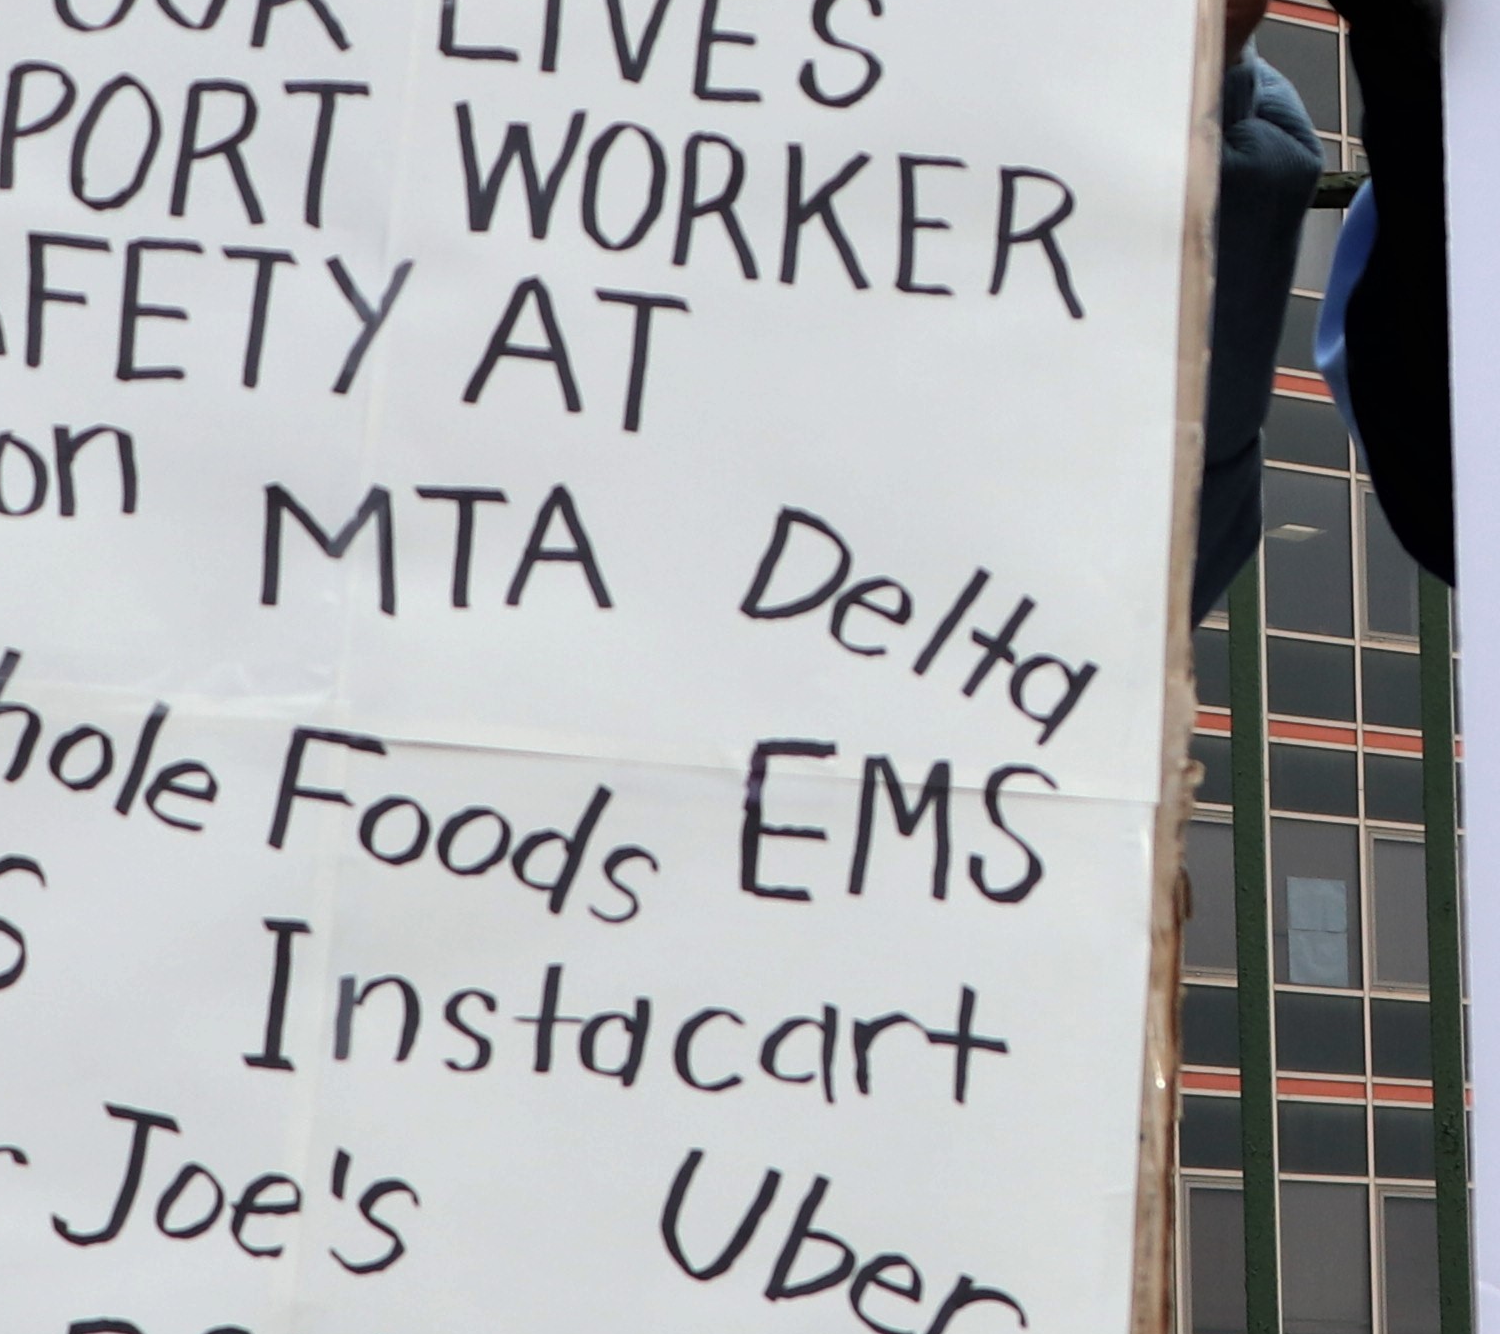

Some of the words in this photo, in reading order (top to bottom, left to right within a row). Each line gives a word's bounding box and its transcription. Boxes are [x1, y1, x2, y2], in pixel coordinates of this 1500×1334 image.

[456, 103, 1083, 319] WORKER
[463, 278, 688, 432] AT
[262, 485, 612, 615] MTA
[740, 508, 1097, 745] Delta
[269, 728, 657, 923] Foods
[741, 741, 1055, 903] EMS
[244, 920, 1007, 1103] Instacart
[53, 1105, 418, 1274] Joe's
